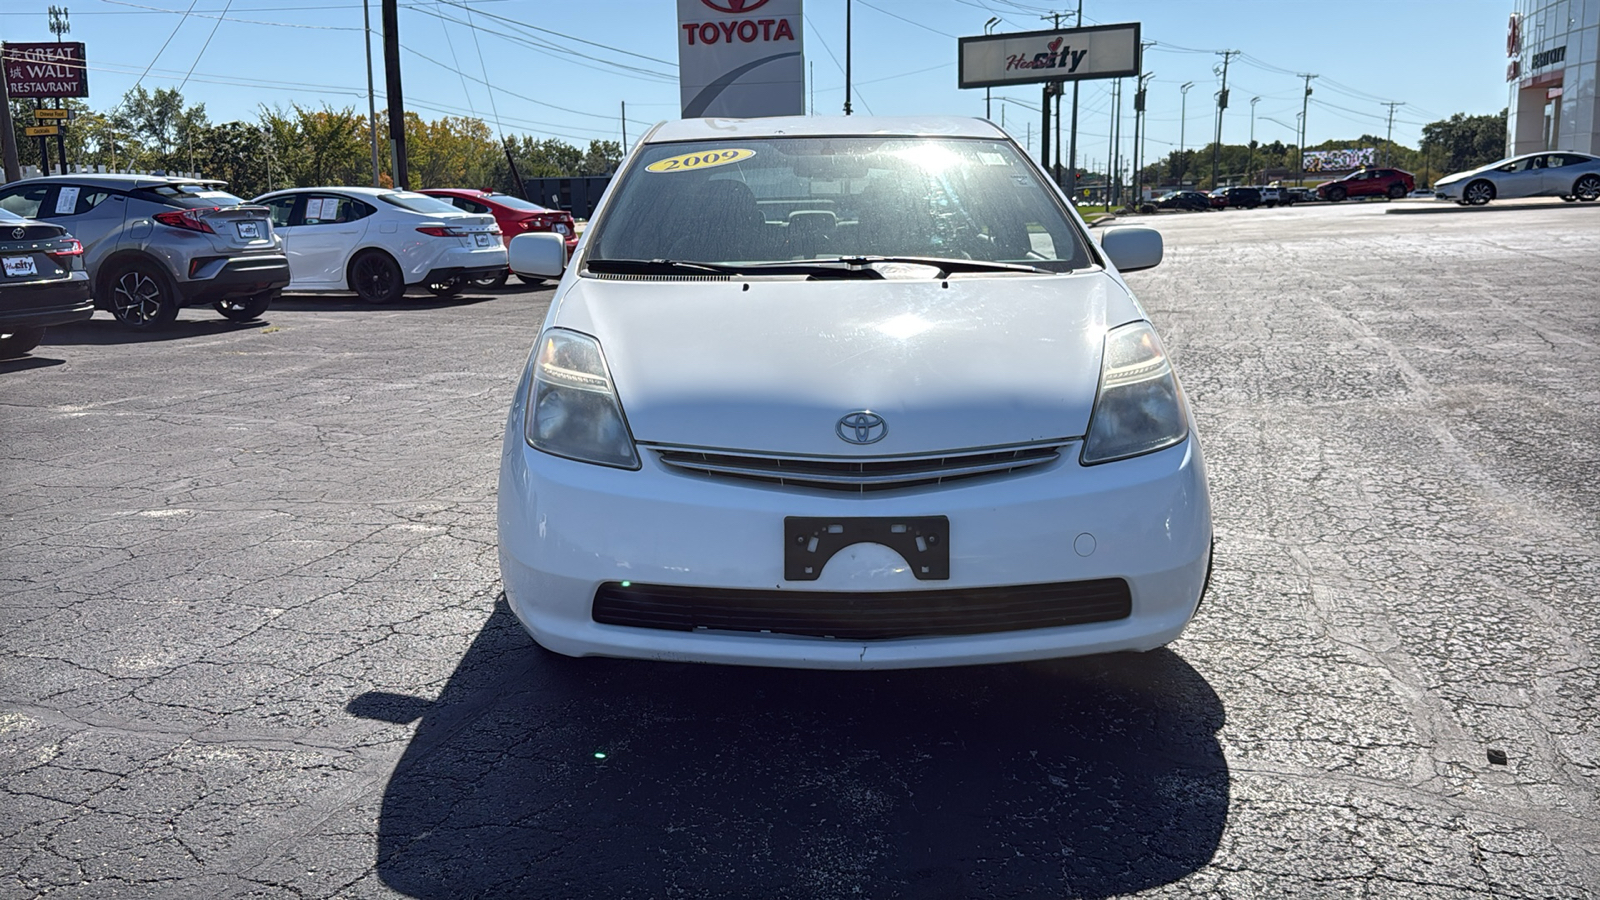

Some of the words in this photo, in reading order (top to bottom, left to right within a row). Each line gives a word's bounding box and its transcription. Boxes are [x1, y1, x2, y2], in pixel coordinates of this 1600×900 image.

[682, 19, 795, 45] TOYOTA
[25, 47, 75, 61] GREAT
[26, 65, 75, 78] WALL
[10, 82, 78, 93] RESTAURANT
[663, 150, 739, 171] 2009
